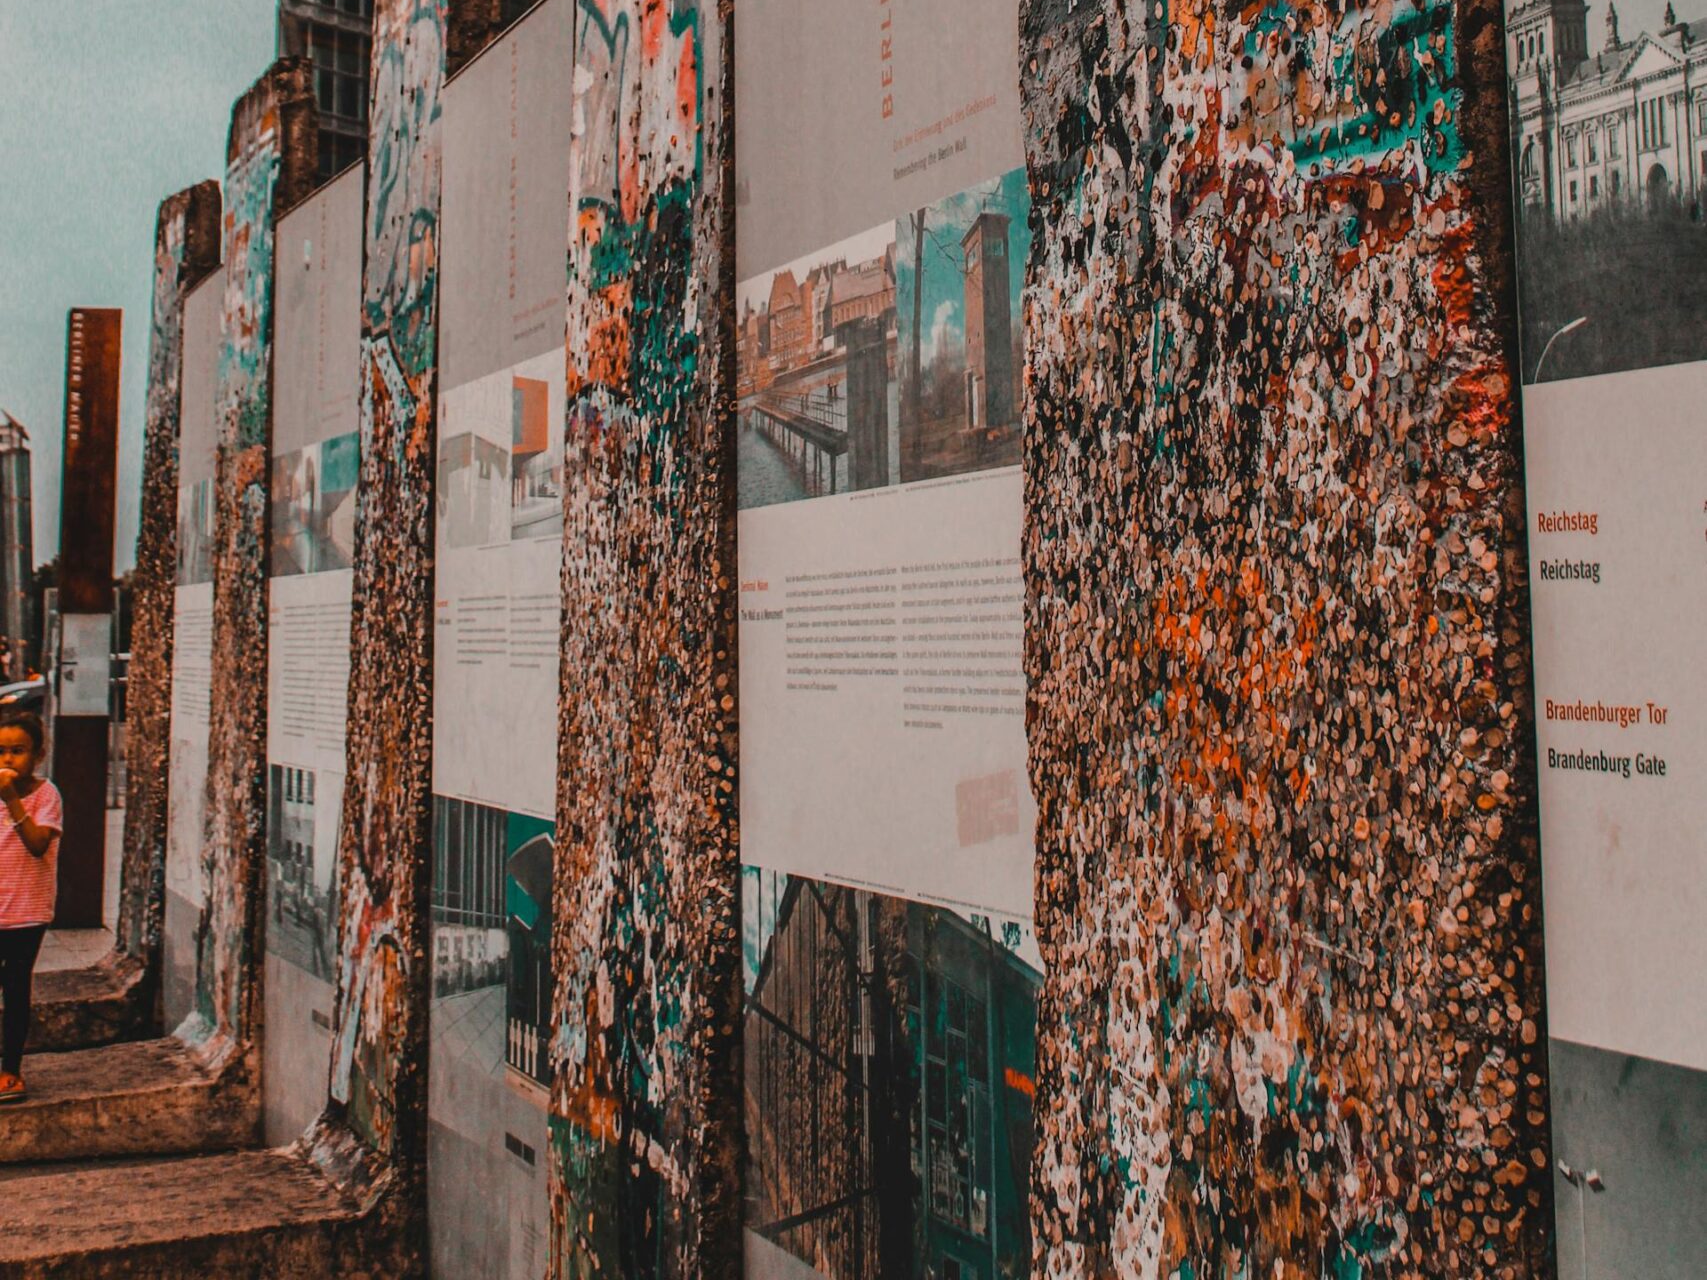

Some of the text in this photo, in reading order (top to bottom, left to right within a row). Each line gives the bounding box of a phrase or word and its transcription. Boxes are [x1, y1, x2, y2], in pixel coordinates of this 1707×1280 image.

[938, 144, 954, 161] Berlin
[955, 136, 967, 153] Wall
[1538, 511, 1598, 535] Reichstag
[1540, 560, 1600, 584] Reichstag
[1546, 699, 1668, 728] Brandenburger Tor
[1548, 748, 1666, 778] Brandenburg Gate
